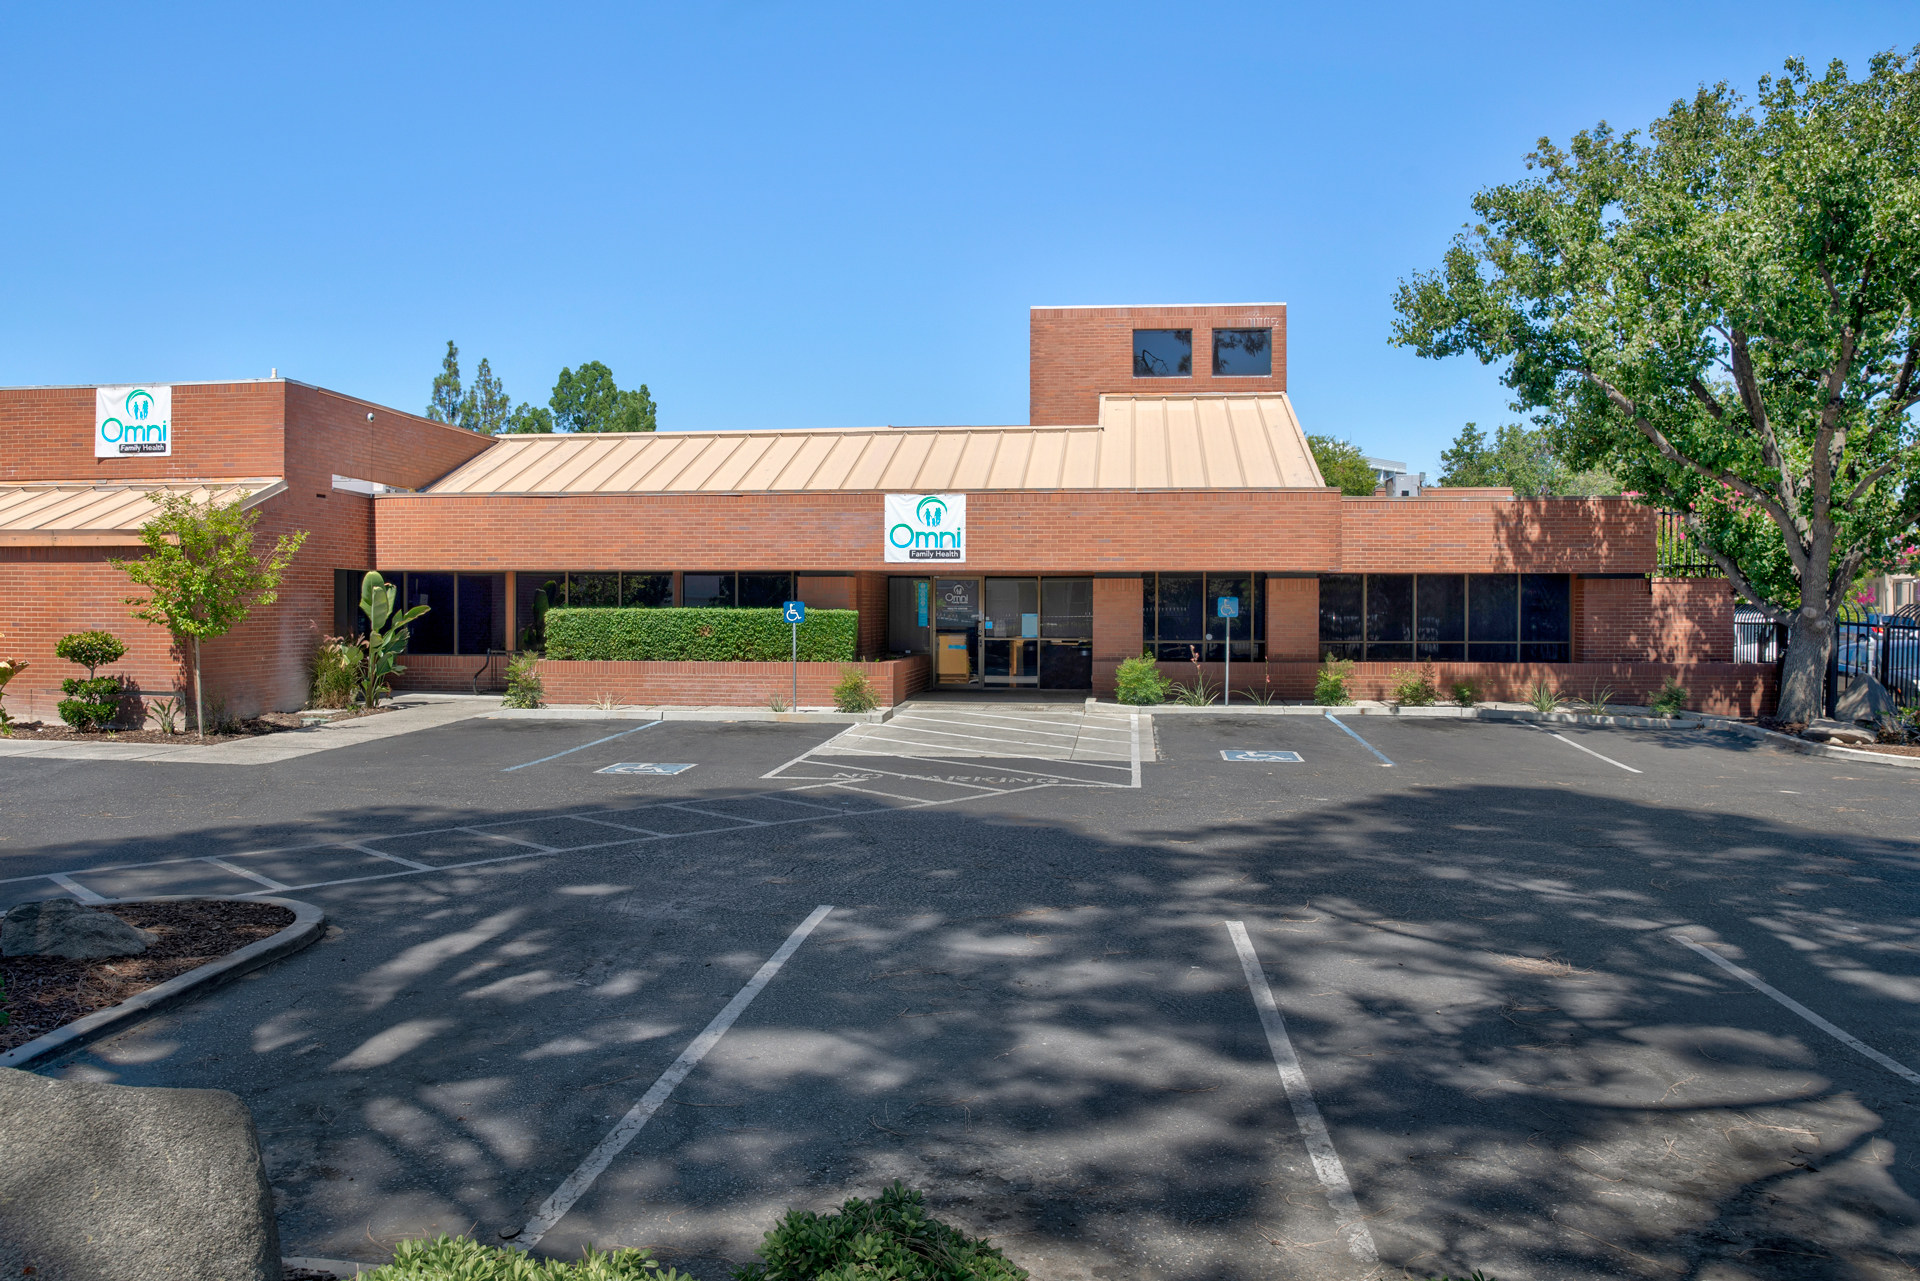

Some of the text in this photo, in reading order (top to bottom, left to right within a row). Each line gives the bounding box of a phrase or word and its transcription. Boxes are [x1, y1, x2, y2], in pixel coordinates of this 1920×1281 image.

[101, 417, 167, 443] Omni
[120, 443, 165, 453] Family Health
[889, 523, 961, 549] Omni
[911, 550, 934, 559] Family
[945, 592, 969, 602] Omni
[831, 772, 884, 780] NO
